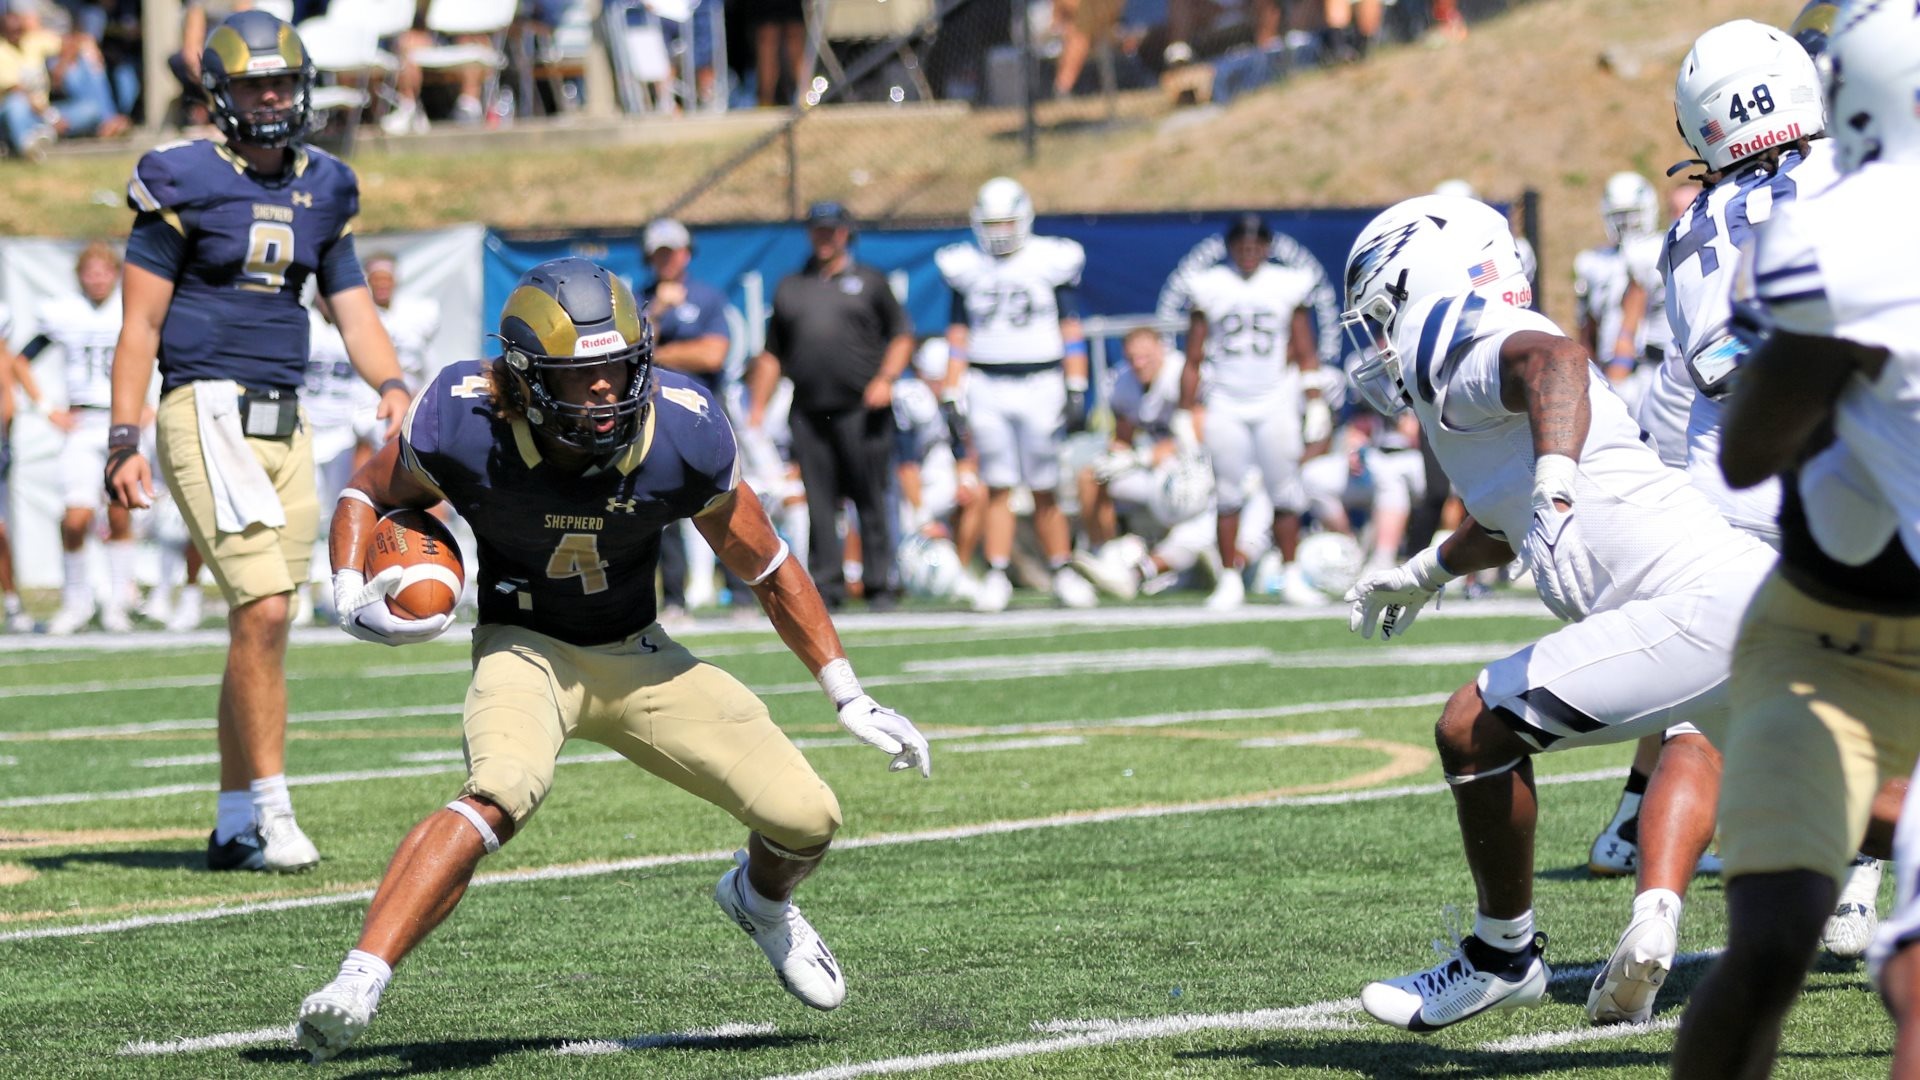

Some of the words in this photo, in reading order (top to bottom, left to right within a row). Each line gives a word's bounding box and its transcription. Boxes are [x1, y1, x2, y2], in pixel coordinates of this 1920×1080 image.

[1729, 122, 1802, 160] Riddell
[238, 220, 295, 292] 9
[581, 334, 619, 349] Riddell
[1221, 313, 1274, 356] 25
[661, 385, 709, 414] 4
[543, 514, 604, 531] SHEPHERD
[545, 533, 610, 595] 4
